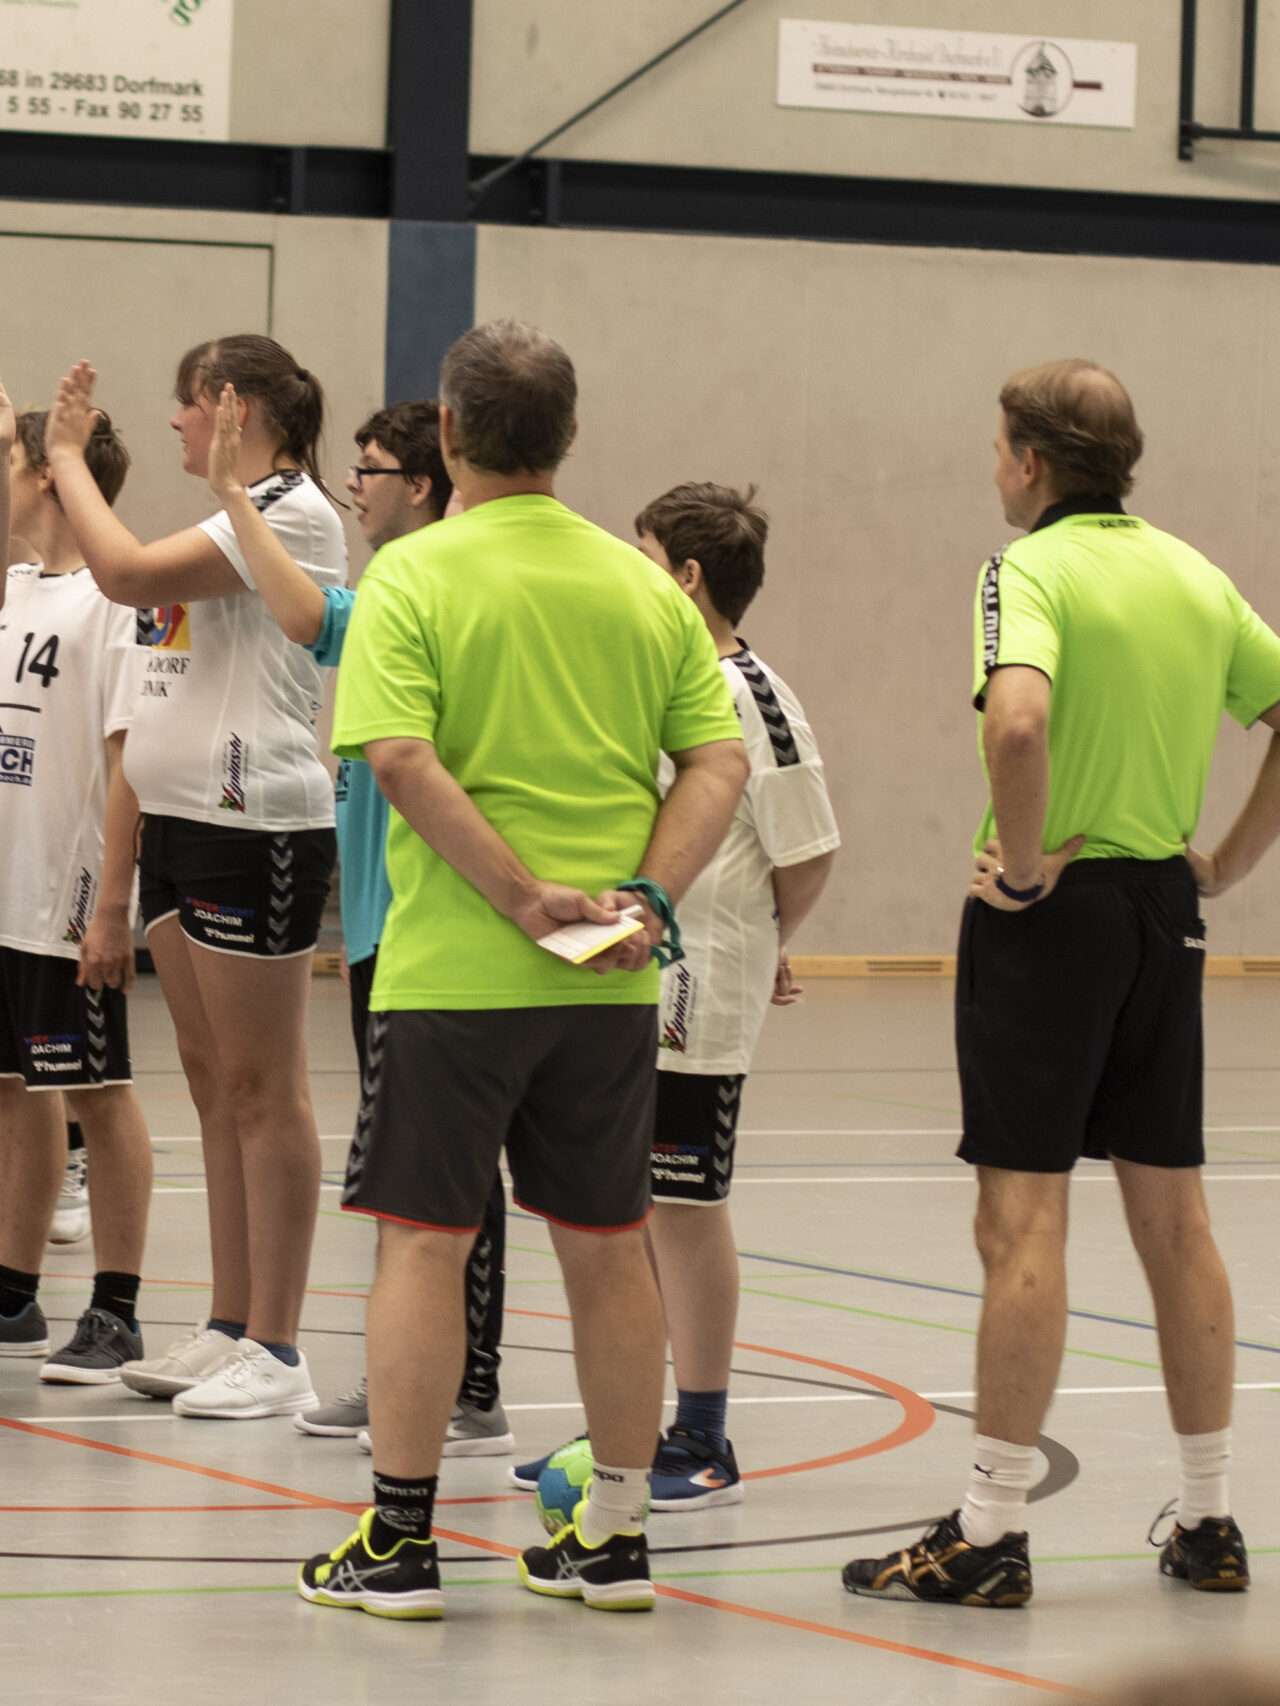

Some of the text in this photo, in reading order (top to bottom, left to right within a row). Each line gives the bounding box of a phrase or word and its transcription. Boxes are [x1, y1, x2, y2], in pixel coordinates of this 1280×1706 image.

[26, 70, 44, 88] in
[50, 72, 107, 92] 29683
[113, 75, 203, 96] Dorfmark
[8, 95, 19, 113] 5
[28, 96, 51, 115] 55
[74, 99, 109, 118] Fax
[118, 101, 141, 119] 90
[149, 103, 171, 121] 27
[180, 104, 203, 122] 55
[15, 632, 60, 688] 14
[193, 907, 242, 927] JOACHIM
